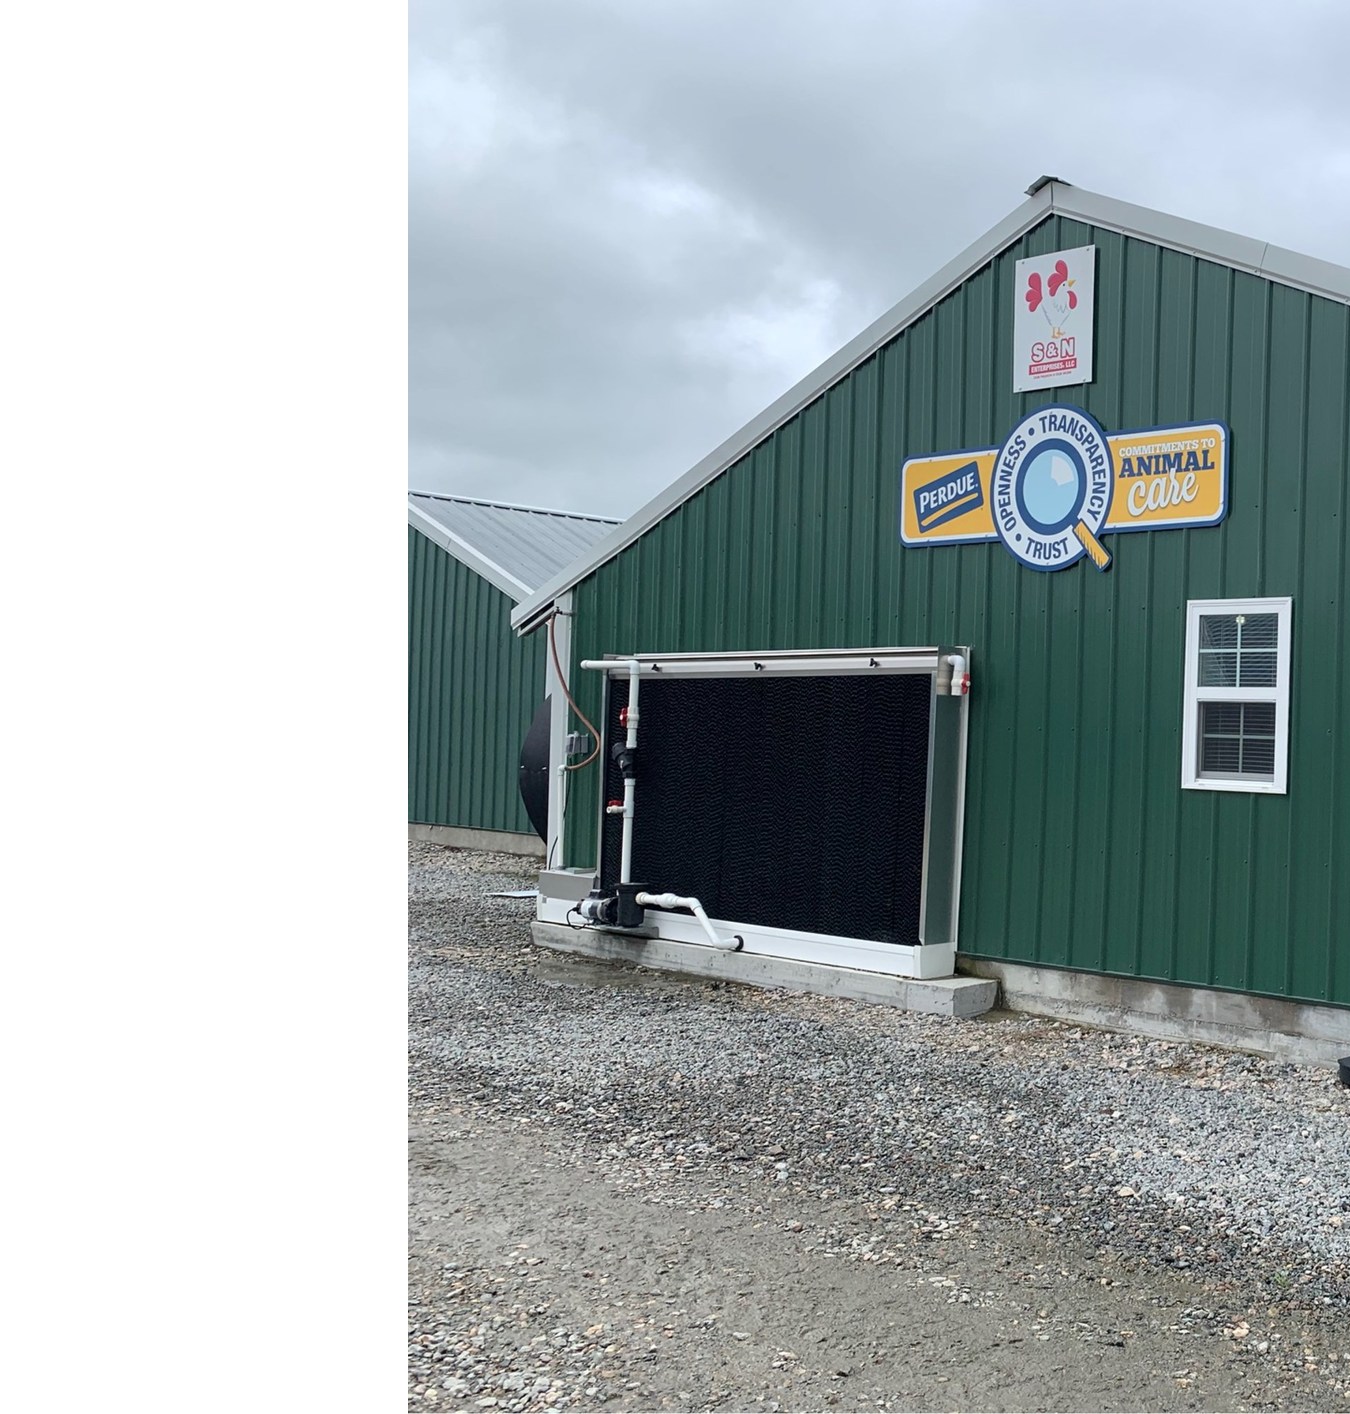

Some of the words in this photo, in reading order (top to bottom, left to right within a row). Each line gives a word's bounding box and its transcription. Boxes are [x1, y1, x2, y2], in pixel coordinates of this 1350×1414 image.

[1119, 439, 1199, 457] COMMITMENTS
[1201, 437, 1216, 449] TO
[1039, 414, 1106, 522] TRANSPARENCY
[1119, 449, 1215, 478] ANIMAL
[998, 434, 1027, 532] OPENNESS
[1025, 537, 1068, 560] TRUST
